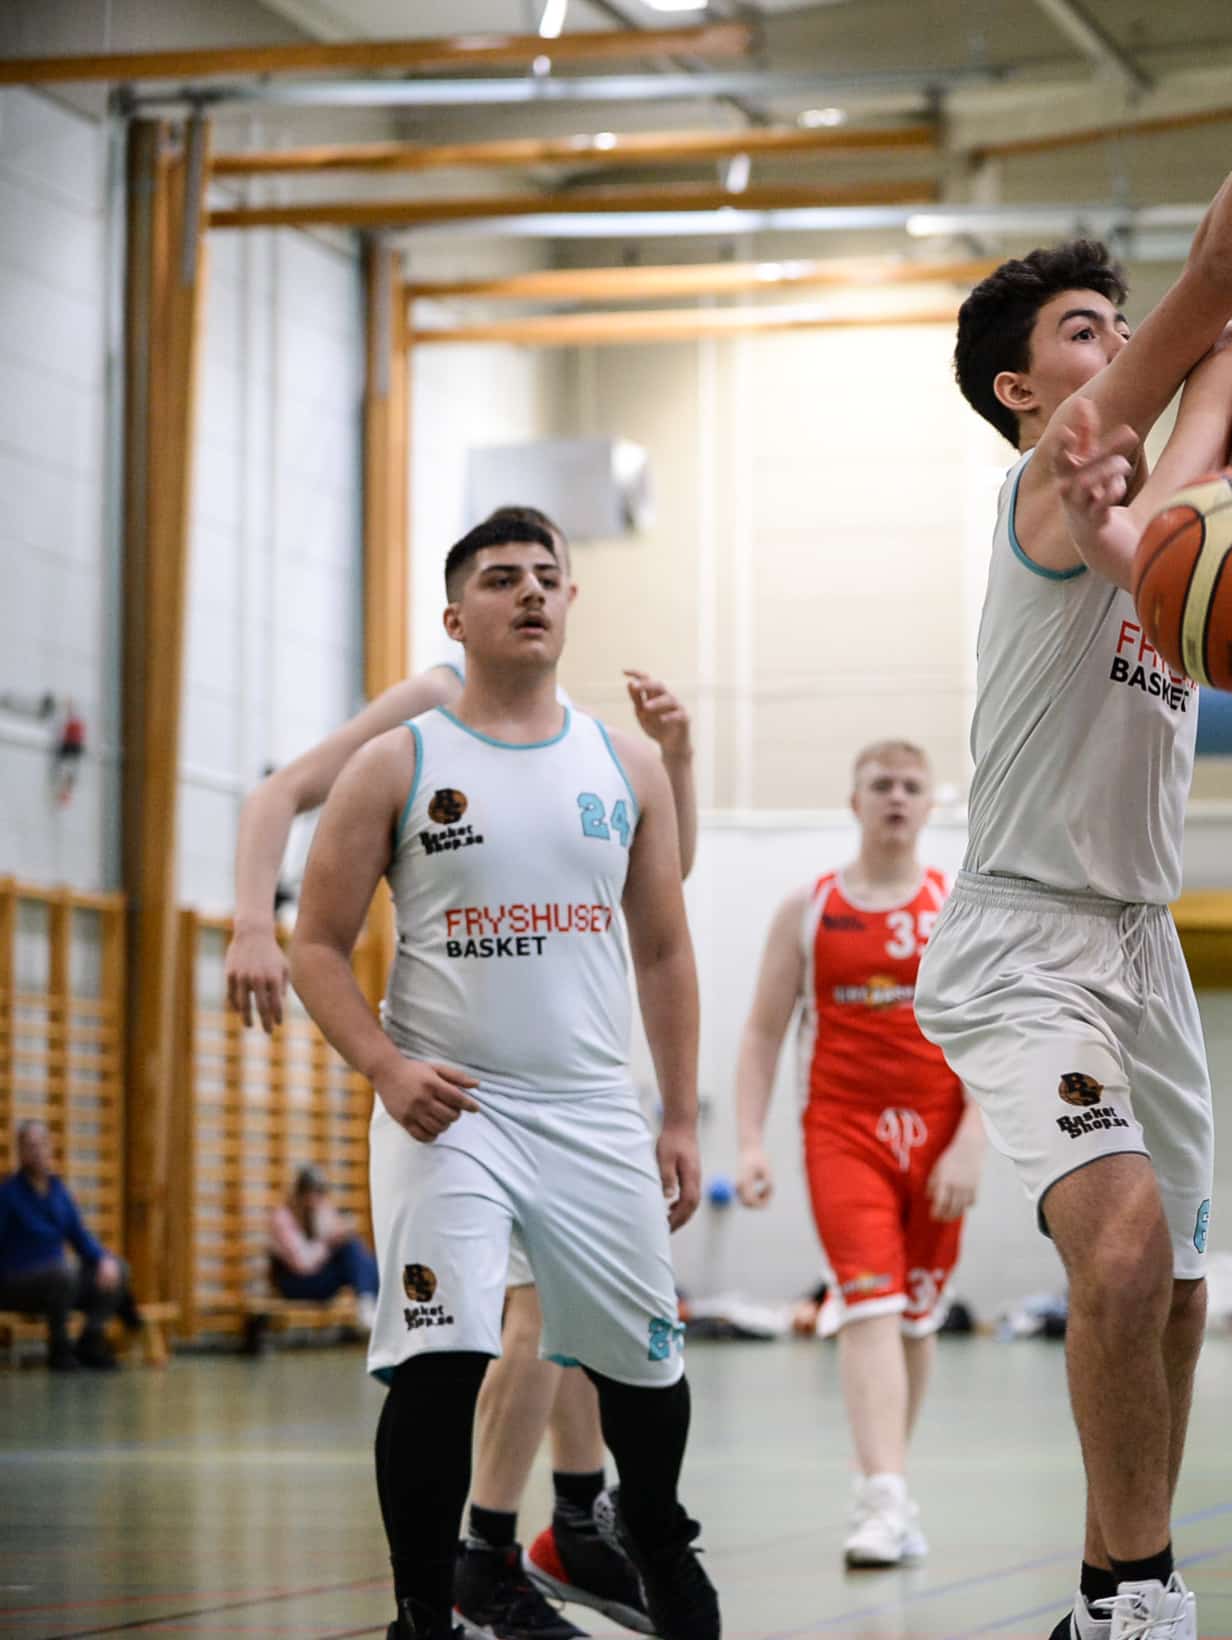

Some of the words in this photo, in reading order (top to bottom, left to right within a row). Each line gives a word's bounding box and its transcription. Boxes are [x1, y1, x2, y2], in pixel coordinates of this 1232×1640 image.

[577, 792, 630, 847] 24
[446, 936, 547, 958] BASKET
[1056, 1107, 1117, 1133] Basket
